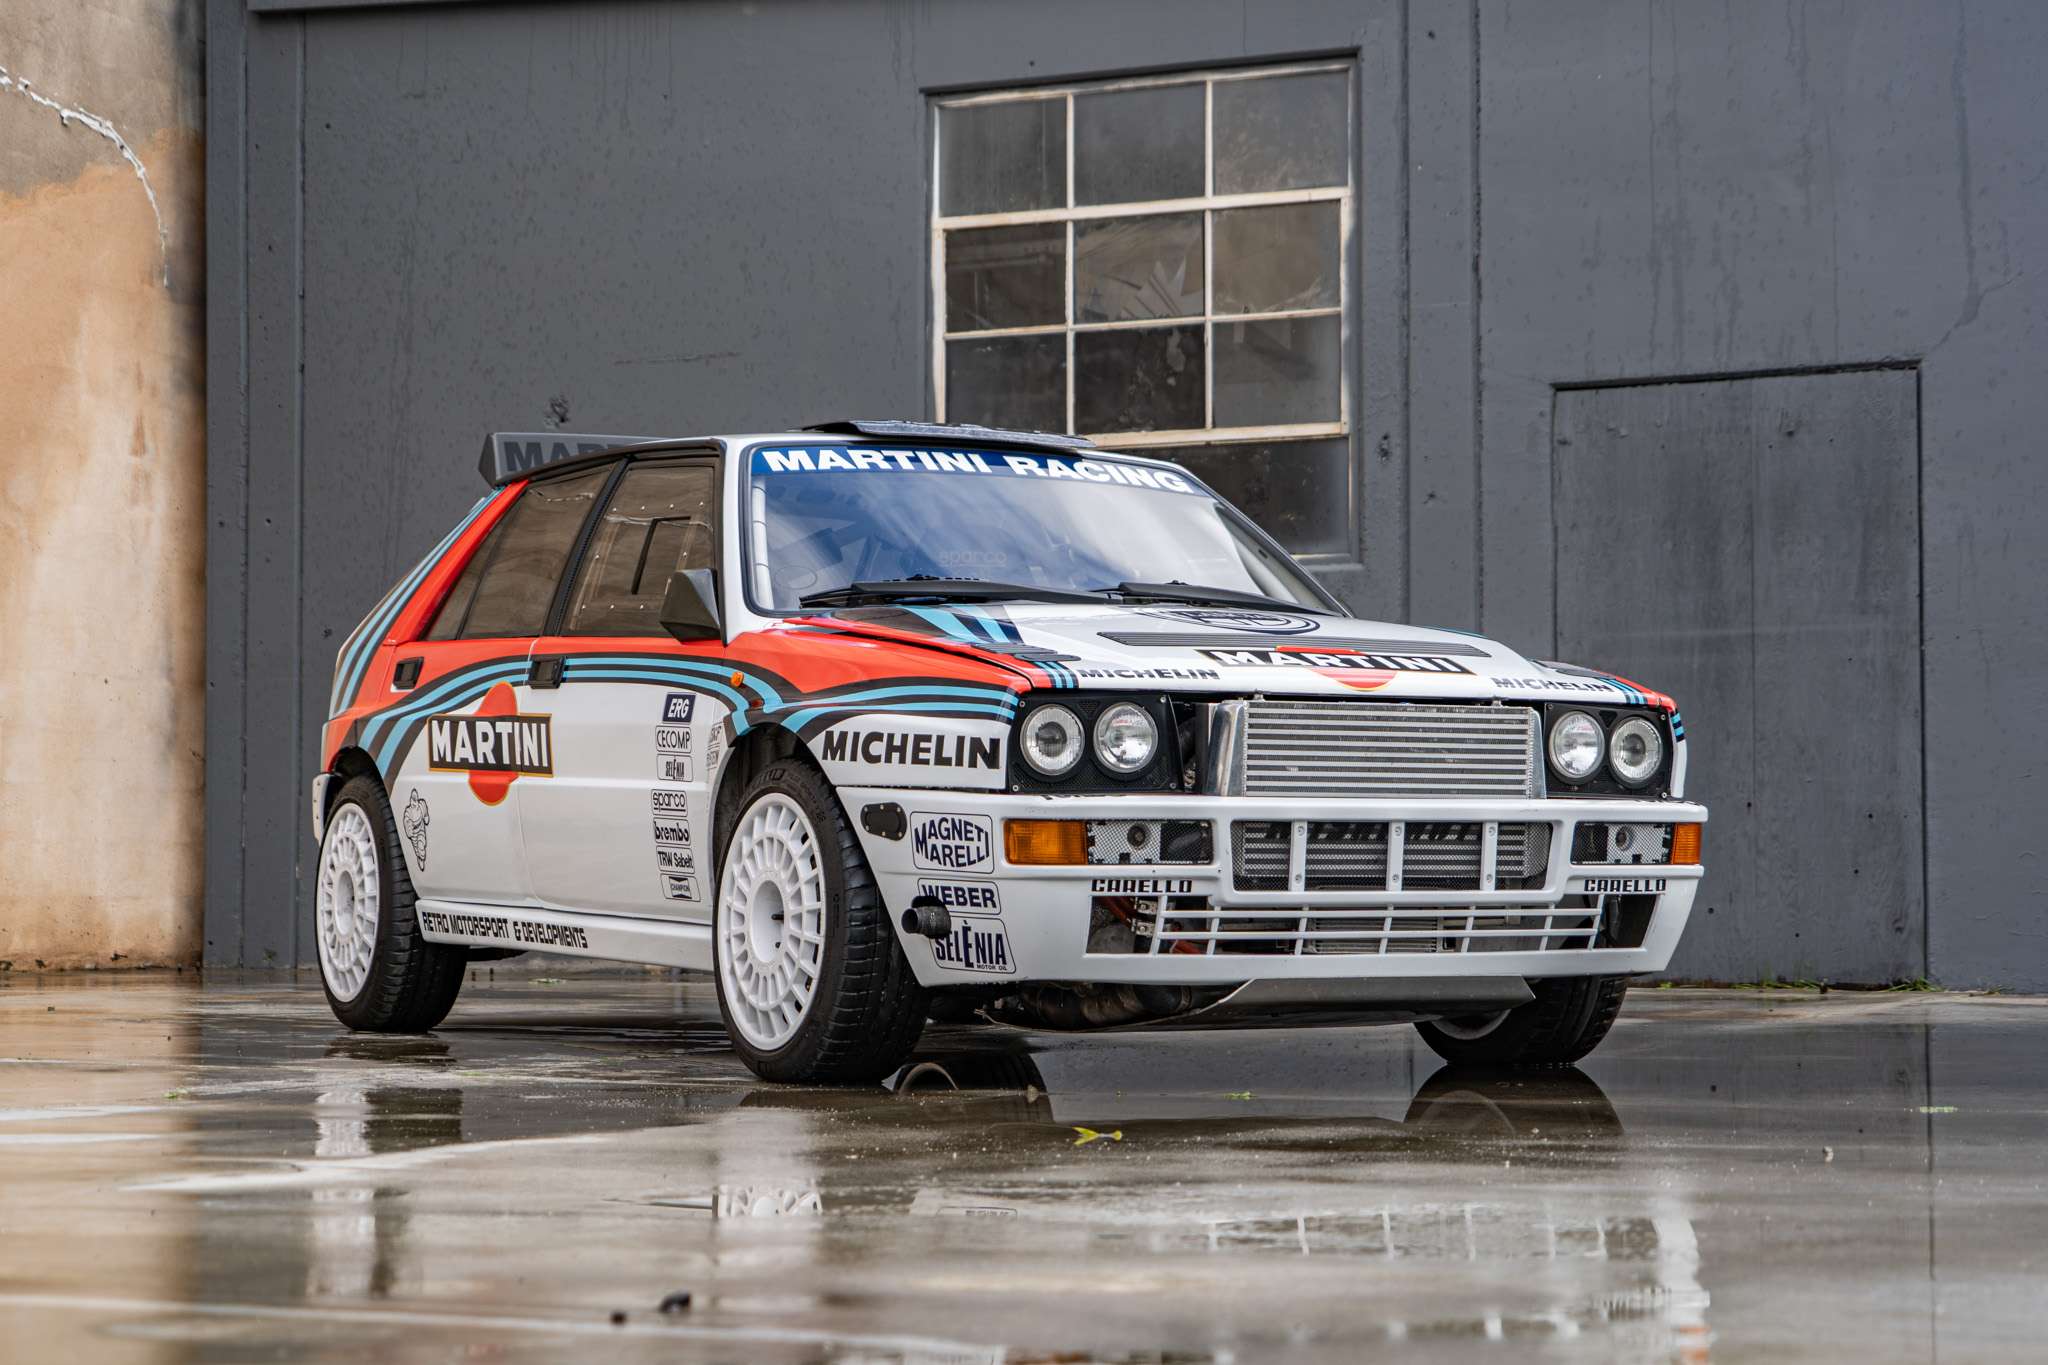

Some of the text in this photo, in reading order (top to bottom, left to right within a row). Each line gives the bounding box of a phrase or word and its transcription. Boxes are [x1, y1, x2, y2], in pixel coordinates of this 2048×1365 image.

[762, 449, 1194, 493] MARTINI RACING
[1210, 651, 1462, 672] MARTINI
[1076, 668, 1220, 680] MICHELIN
[1490, 677, 1615, 693] MICHELIN
[667, 698, 690, 719] ERG
[431, 720, 549, 768] MARTINI
[656, 730, 691, 749] CECOMP
[822, 730, 1001, 770] MICHELIN
[653, 792, 686, 811] sparco
[653, 821, 690, 842] brembo
[914, 817, 990, 853] MAGNETI
[658, 851, 673, 867] TRW
[914, 829, 990, 868] MARELLI
[1091, 879, 1193, 893] CARELLO
[1584, 879, 1666, 893] CARELLO
[422, 912, 589, 949] RETRO MOTORSPORT & DEVELOPMENTS
[976, 963, 996, 971] MOTOR
